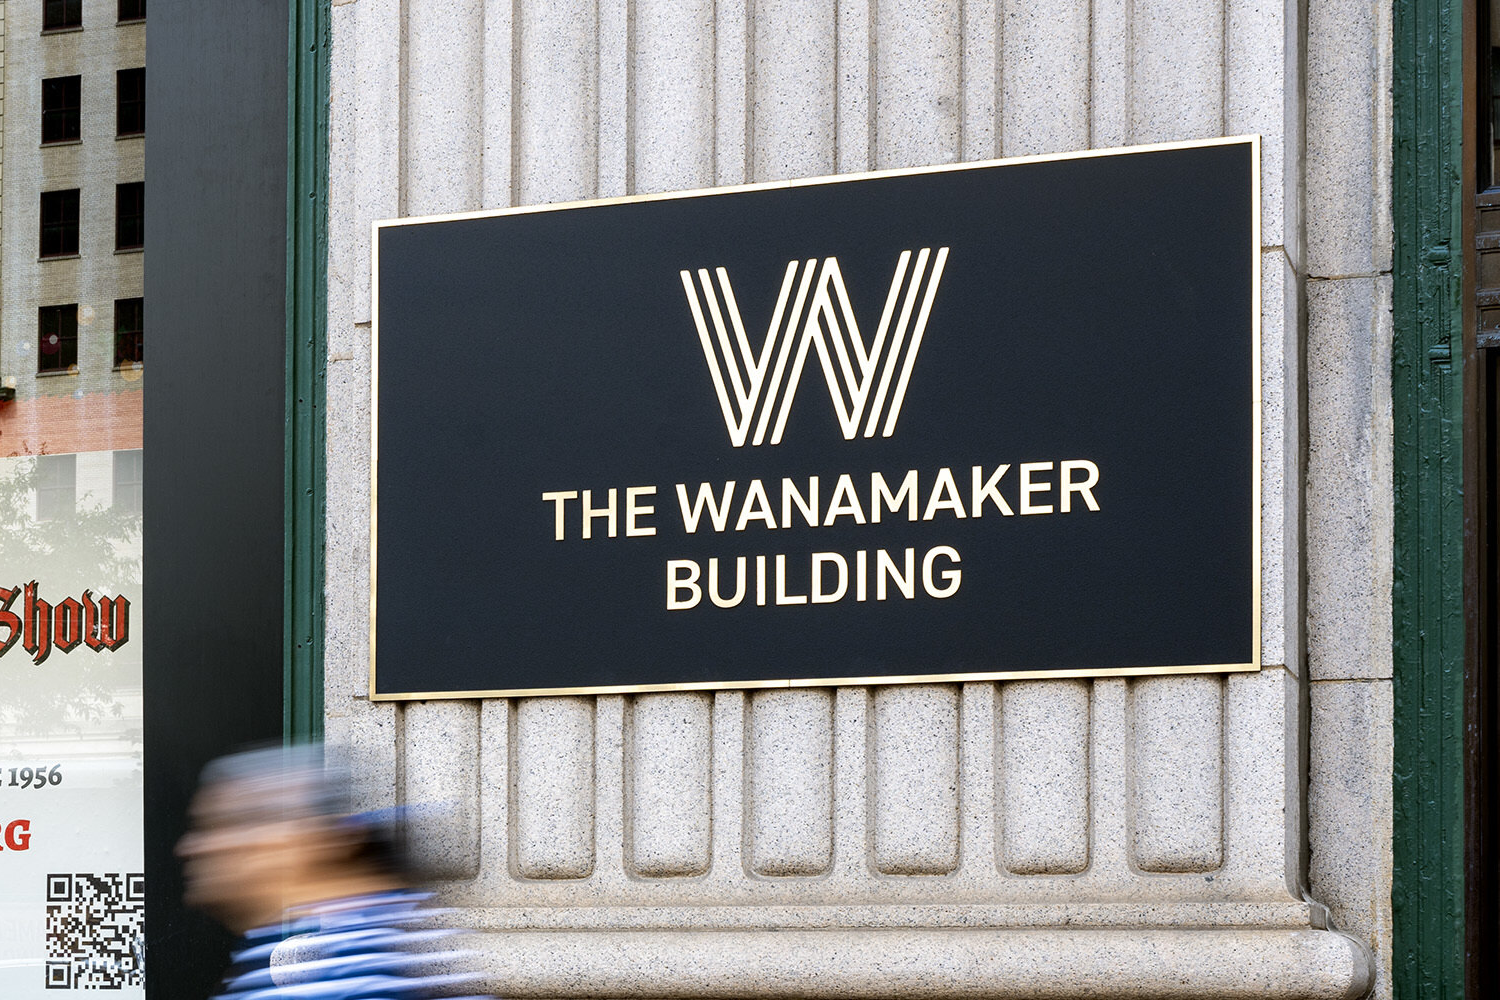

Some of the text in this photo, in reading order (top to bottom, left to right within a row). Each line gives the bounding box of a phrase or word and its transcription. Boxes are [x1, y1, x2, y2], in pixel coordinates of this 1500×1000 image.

[680, 247, 949, 447] W
[543, 459, 1101, 541] THE WANAMAKER
[666, 546, 963, 611] BUILDING
[8, 764, 62, 789] 1956
